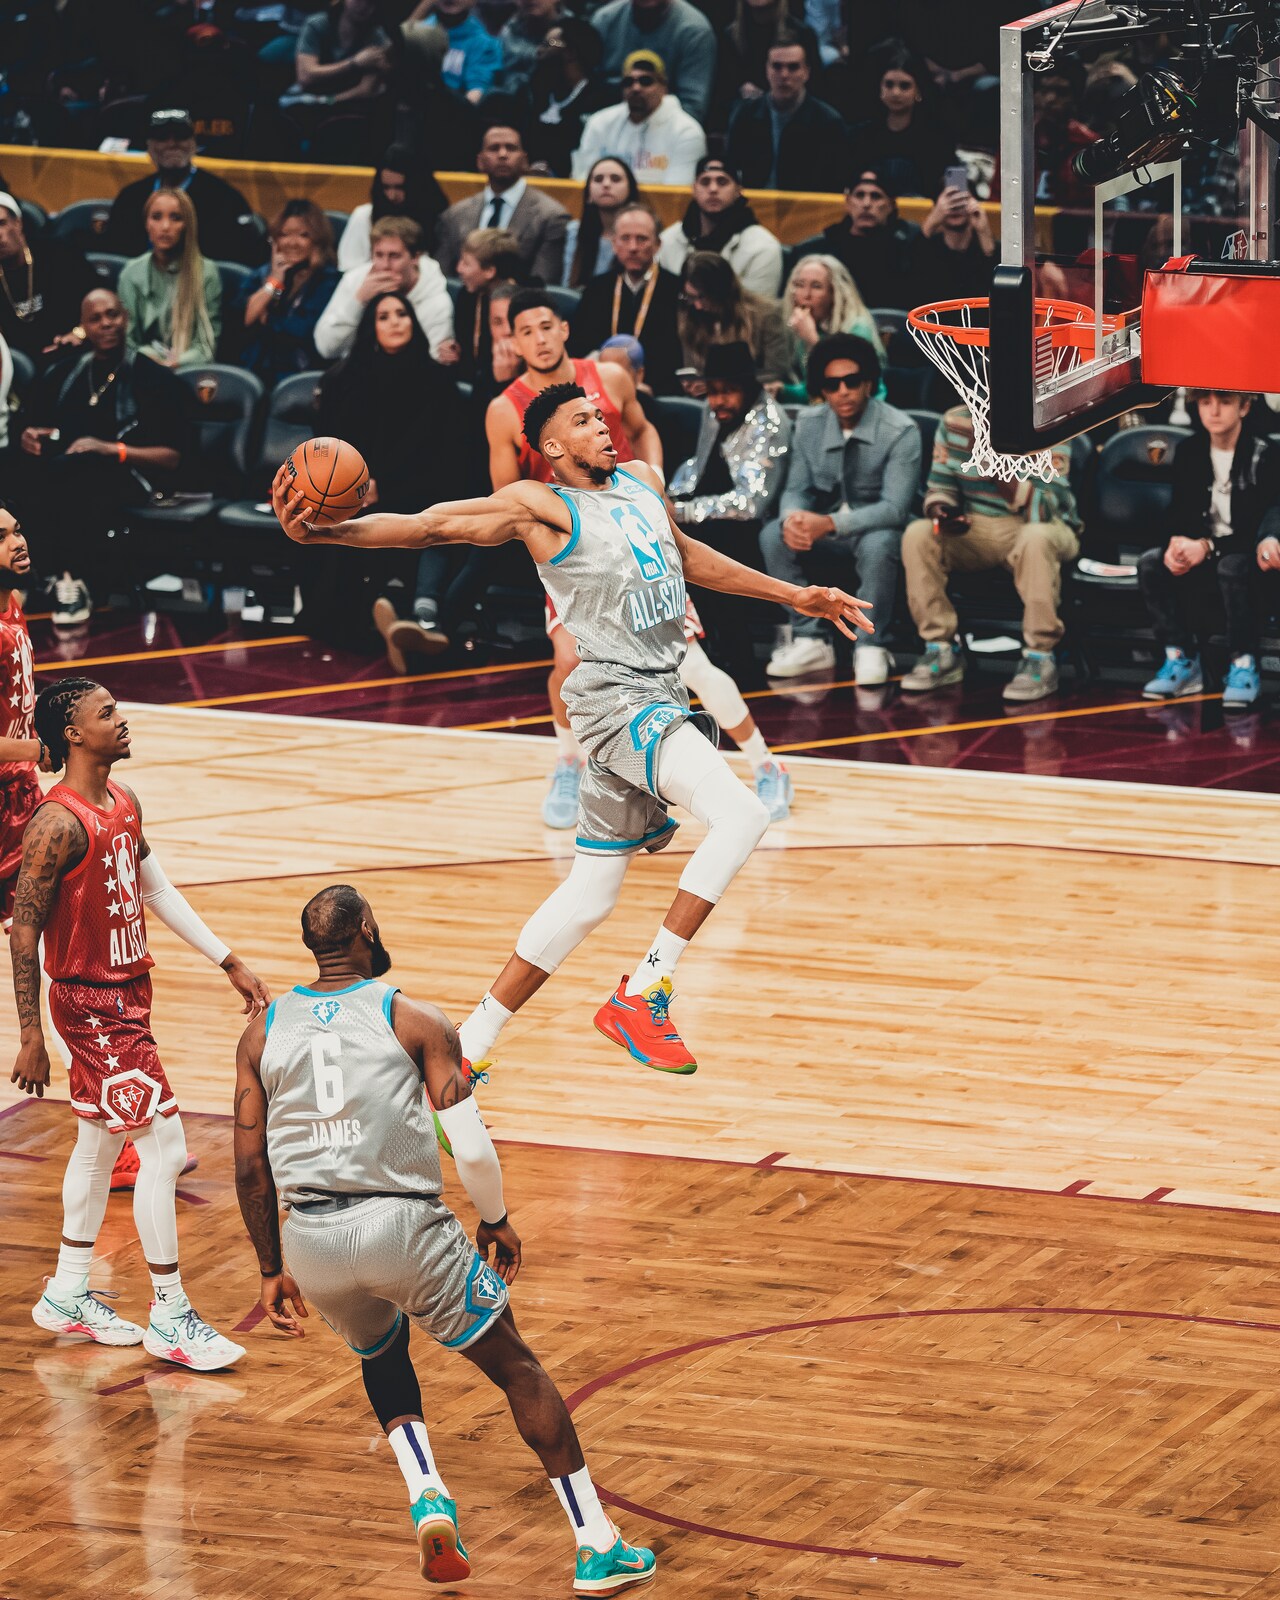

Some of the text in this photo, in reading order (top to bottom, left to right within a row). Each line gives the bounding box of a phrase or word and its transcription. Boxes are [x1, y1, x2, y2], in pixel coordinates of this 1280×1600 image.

[109, 919, 147, 967] ALL-ST
[311, 1032, 345, 1114] 6
[309, 1119, 362, 1148] JAMES
